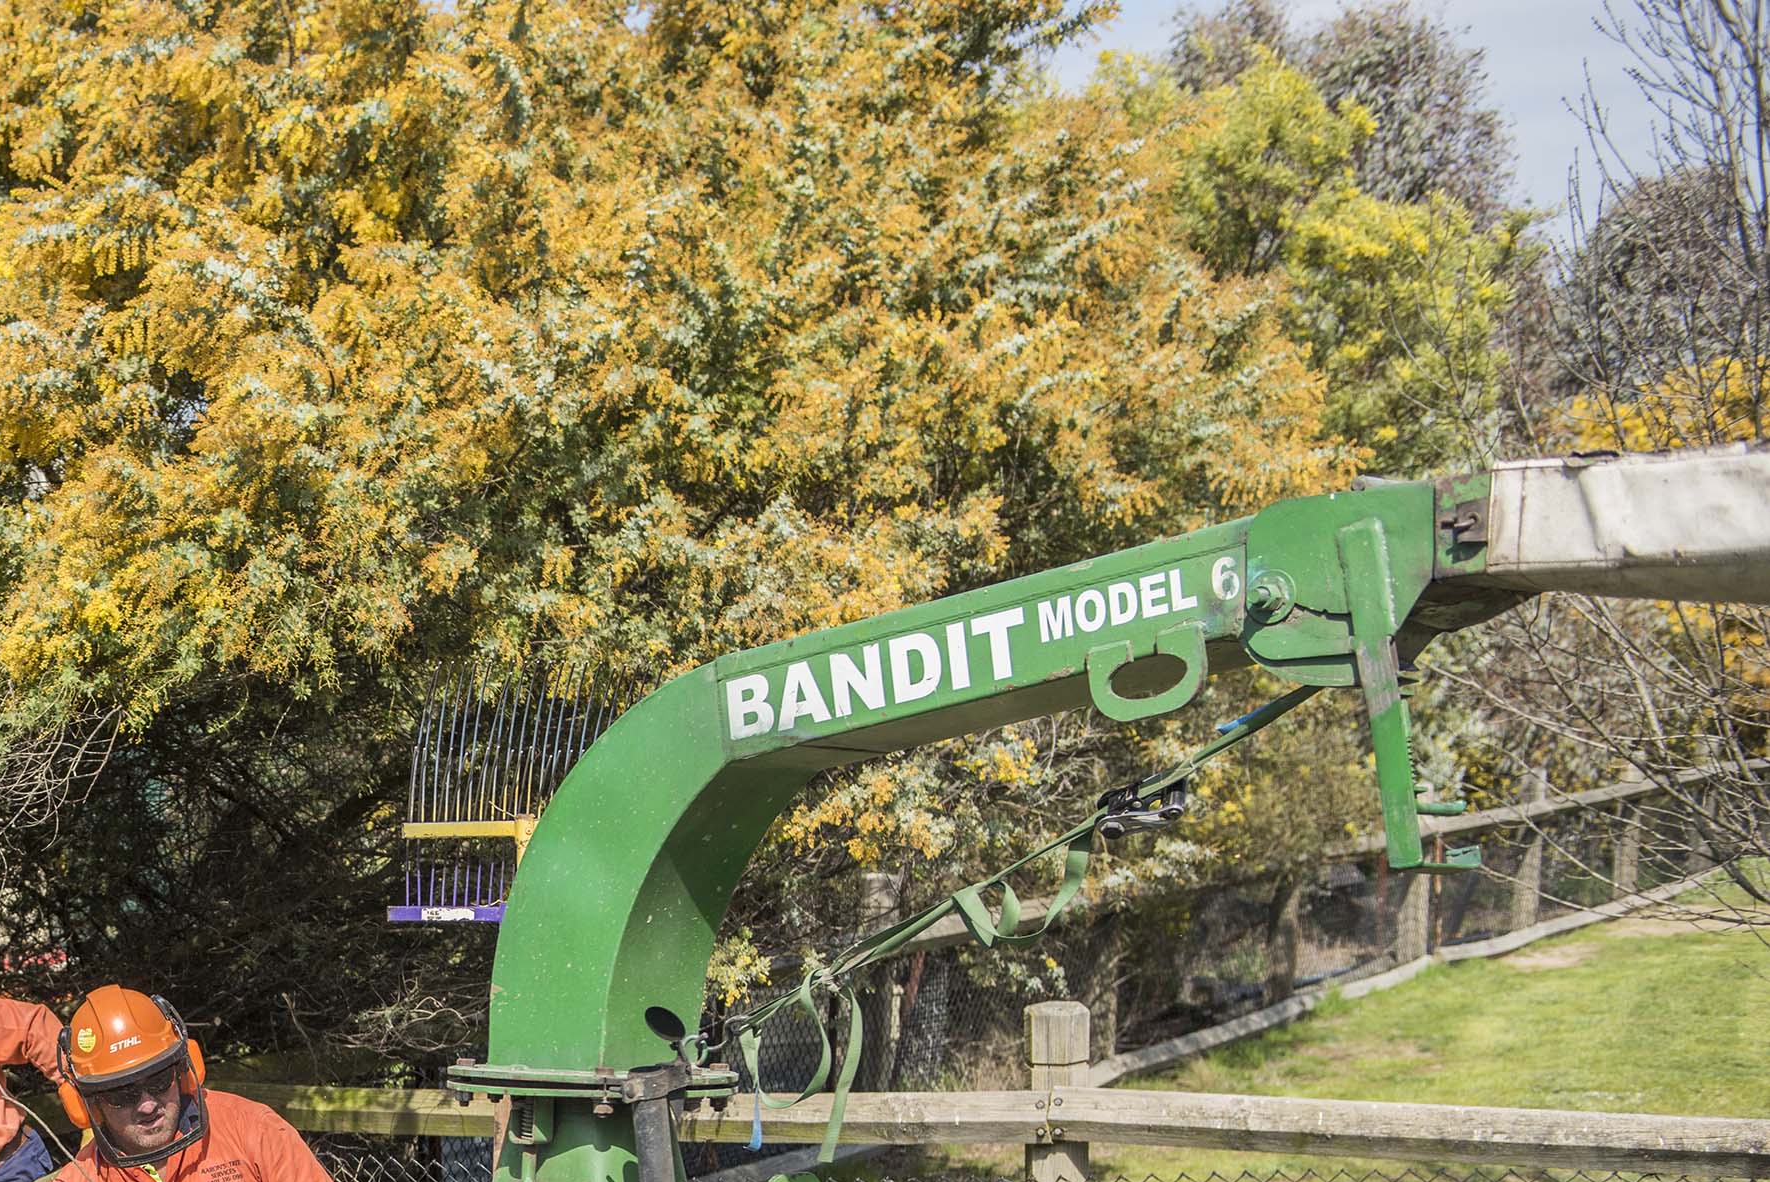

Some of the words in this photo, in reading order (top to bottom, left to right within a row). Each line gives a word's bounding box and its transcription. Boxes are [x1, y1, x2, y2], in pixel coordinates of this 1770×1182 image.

[725, 607, 1025, 742] BANDIT
[1037, 568, 1198, 643] MODEL
[1212, 557, 1240, 601] 6
[110, 1035, 142, 1053] STIHL
[228, 1159, 241, 1167] TREE
[211, 1168, 236, 1179] SERVICES
